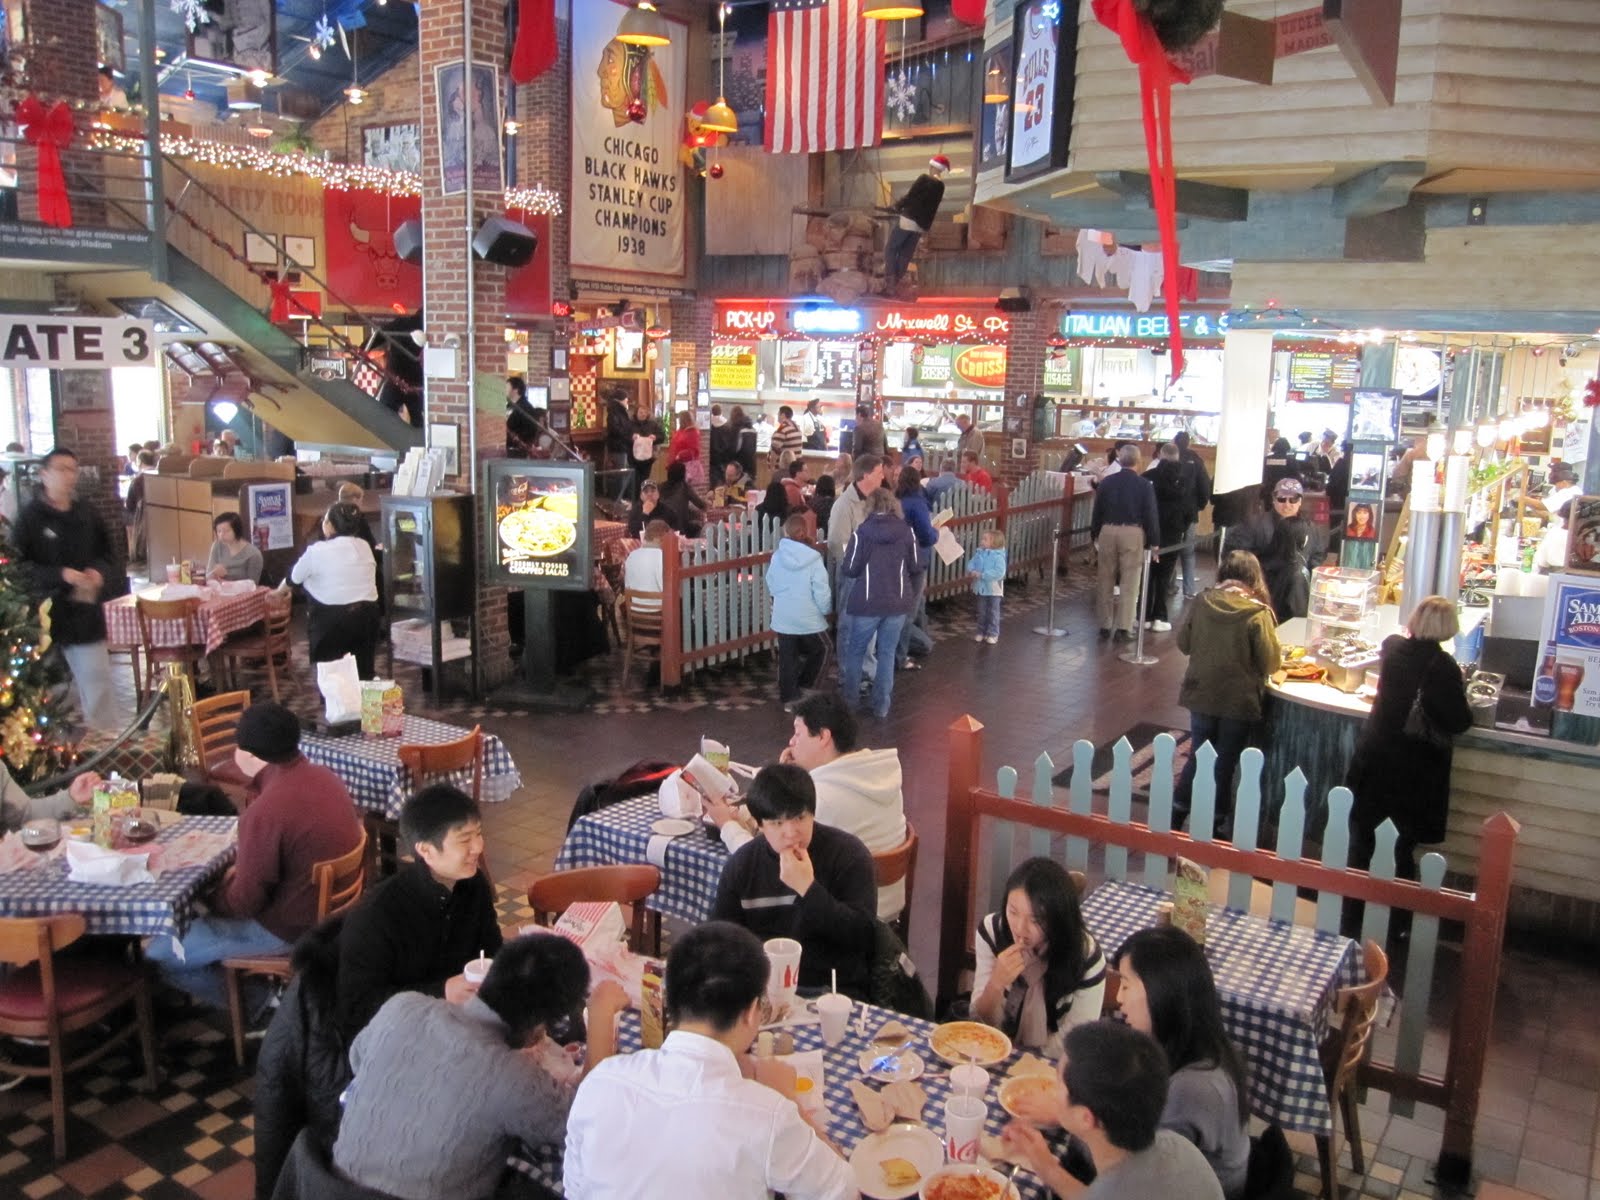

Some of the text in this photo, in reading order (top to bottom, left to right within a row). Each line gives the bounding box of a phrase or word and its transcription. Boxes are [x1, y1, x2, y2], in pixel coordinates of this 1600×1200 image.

[1024, 48, 1049, 90] BULLS
[1024, 83, 1045, 133] 23
[604, 136, 659, 164] CHICAGO
[585, 156, 676, 192] BLACK HAWKS
[589, 183, 673, 215] STANLEY CUP
[595, 209, 667, 237] CHAMPIONS
[50, 237, 80, 248] Chicago
[81, 239, 112, 250] Stadium
[76, 229, 93, 239] gate
[94, 231, 126, 241] entrance
[127, 232, 149, 243] under
[618, 235, 646, 256] 1938
[726, 311, 775, 328] PICK-UP
[877, 313, 949, 331] Maxwell
[1065, 315, 1131, 334] ITALIAN
[3, 324, 149, 361] ATE 3
[509, 566, 569, 576] CHOPPED SALAD
[541, 561, 568, 569] TOSSED
[1568, 599, 1600, 615] SAM
[1568, 624, 1599, 634] BOSTON
